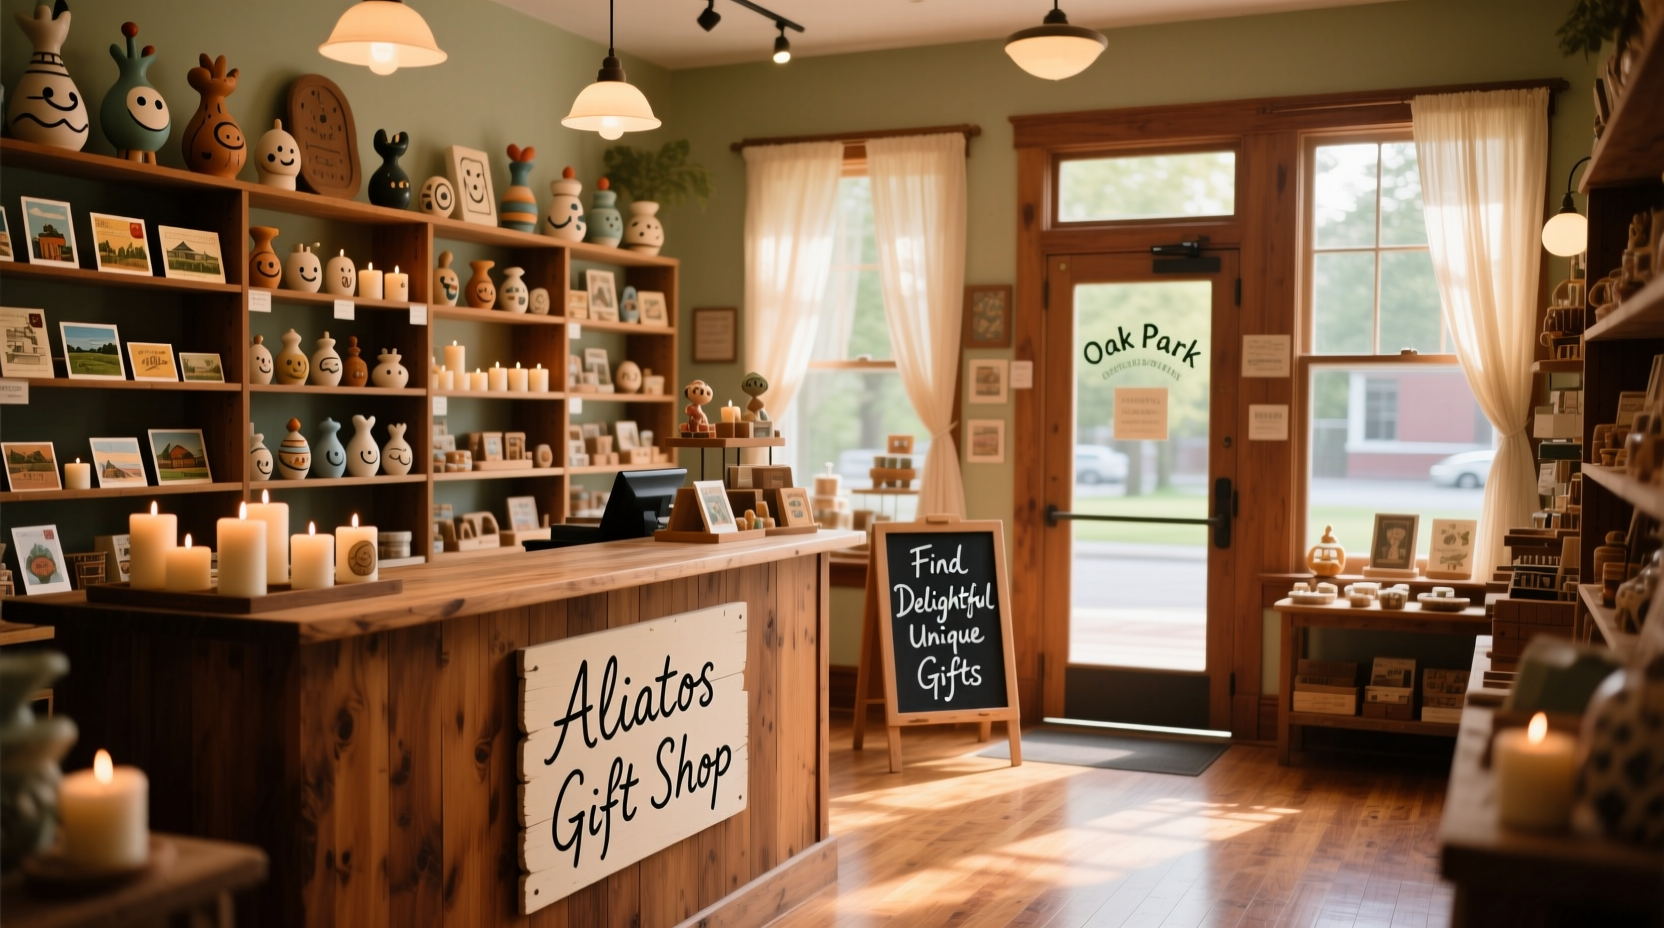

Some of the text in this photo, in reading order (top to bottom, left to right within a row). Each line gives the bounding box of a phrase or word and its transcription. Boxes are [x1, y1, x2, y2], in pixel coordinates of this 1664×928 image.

[1083, 326, 1135, 365] Oak
[1142, 323, 1202, 369] Park
[909, 544, 969, 578] Find
[893, 582, 995, 624] Delightful
[909, 623, 985, 655] Unique
[917, 655, 982, 702] Gifts
[543, 655, 714, 766] Aliatos
[552, 733, 732, 869] Gift Shop
